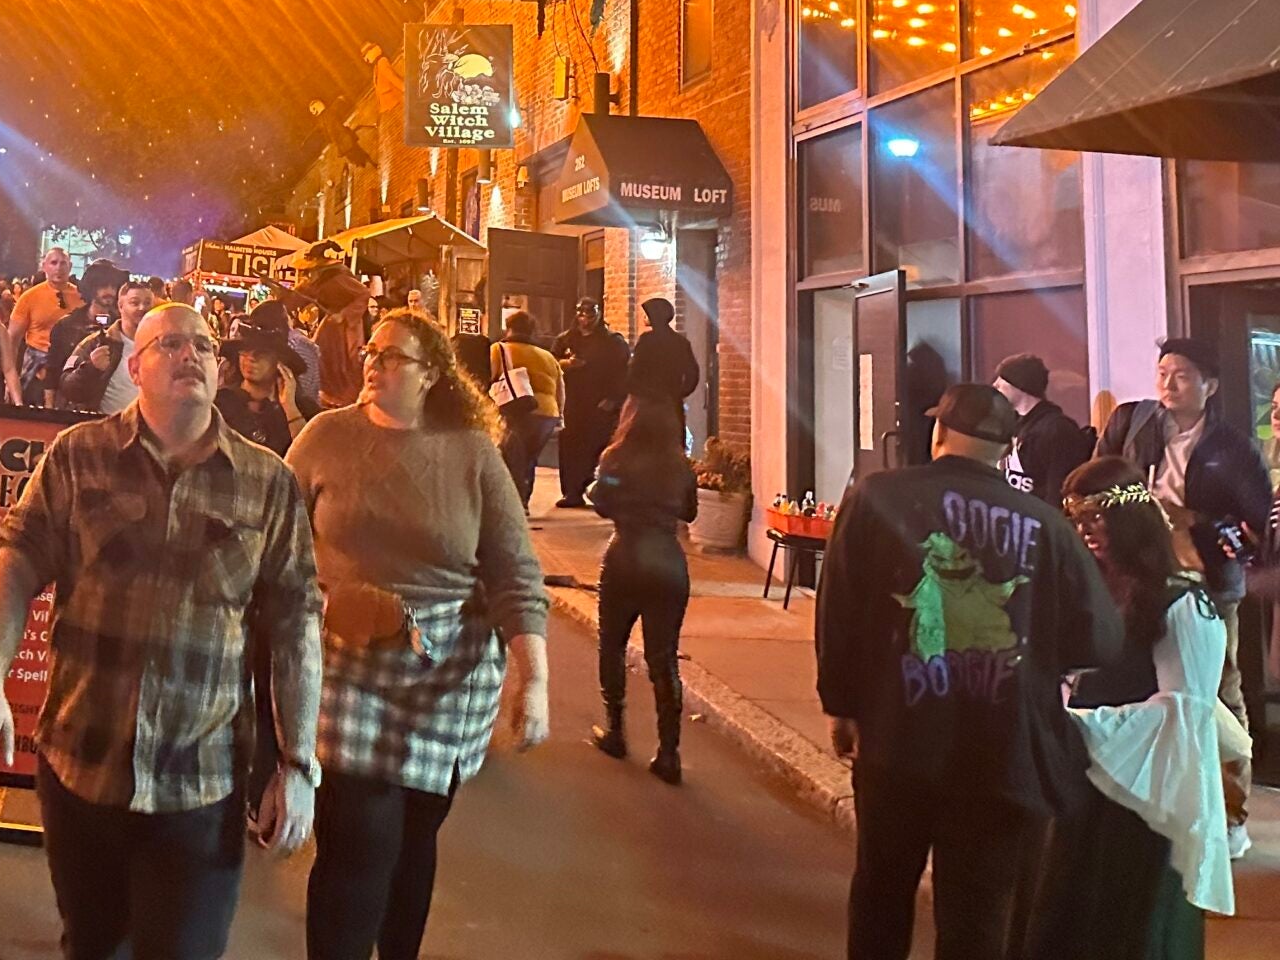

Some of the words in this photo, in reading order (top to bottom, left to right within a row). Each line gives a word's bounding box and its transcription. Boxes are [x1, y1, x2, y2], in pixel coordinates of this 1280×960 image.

[429, 103, 489, 115] Salem
[430, 115, 489, 127] Witch
[424, 126, 495, 141] Village
[562, 182, 583, 203] MUSEUM
[583, 176, 600, 195] LOFTS
[620, 182, 682, 201] MUSEUM
[694, 187, 727, 203] LOFT
[942, 491, 1042, 572] OOGIE
[15, 648, 34, 661] ch
